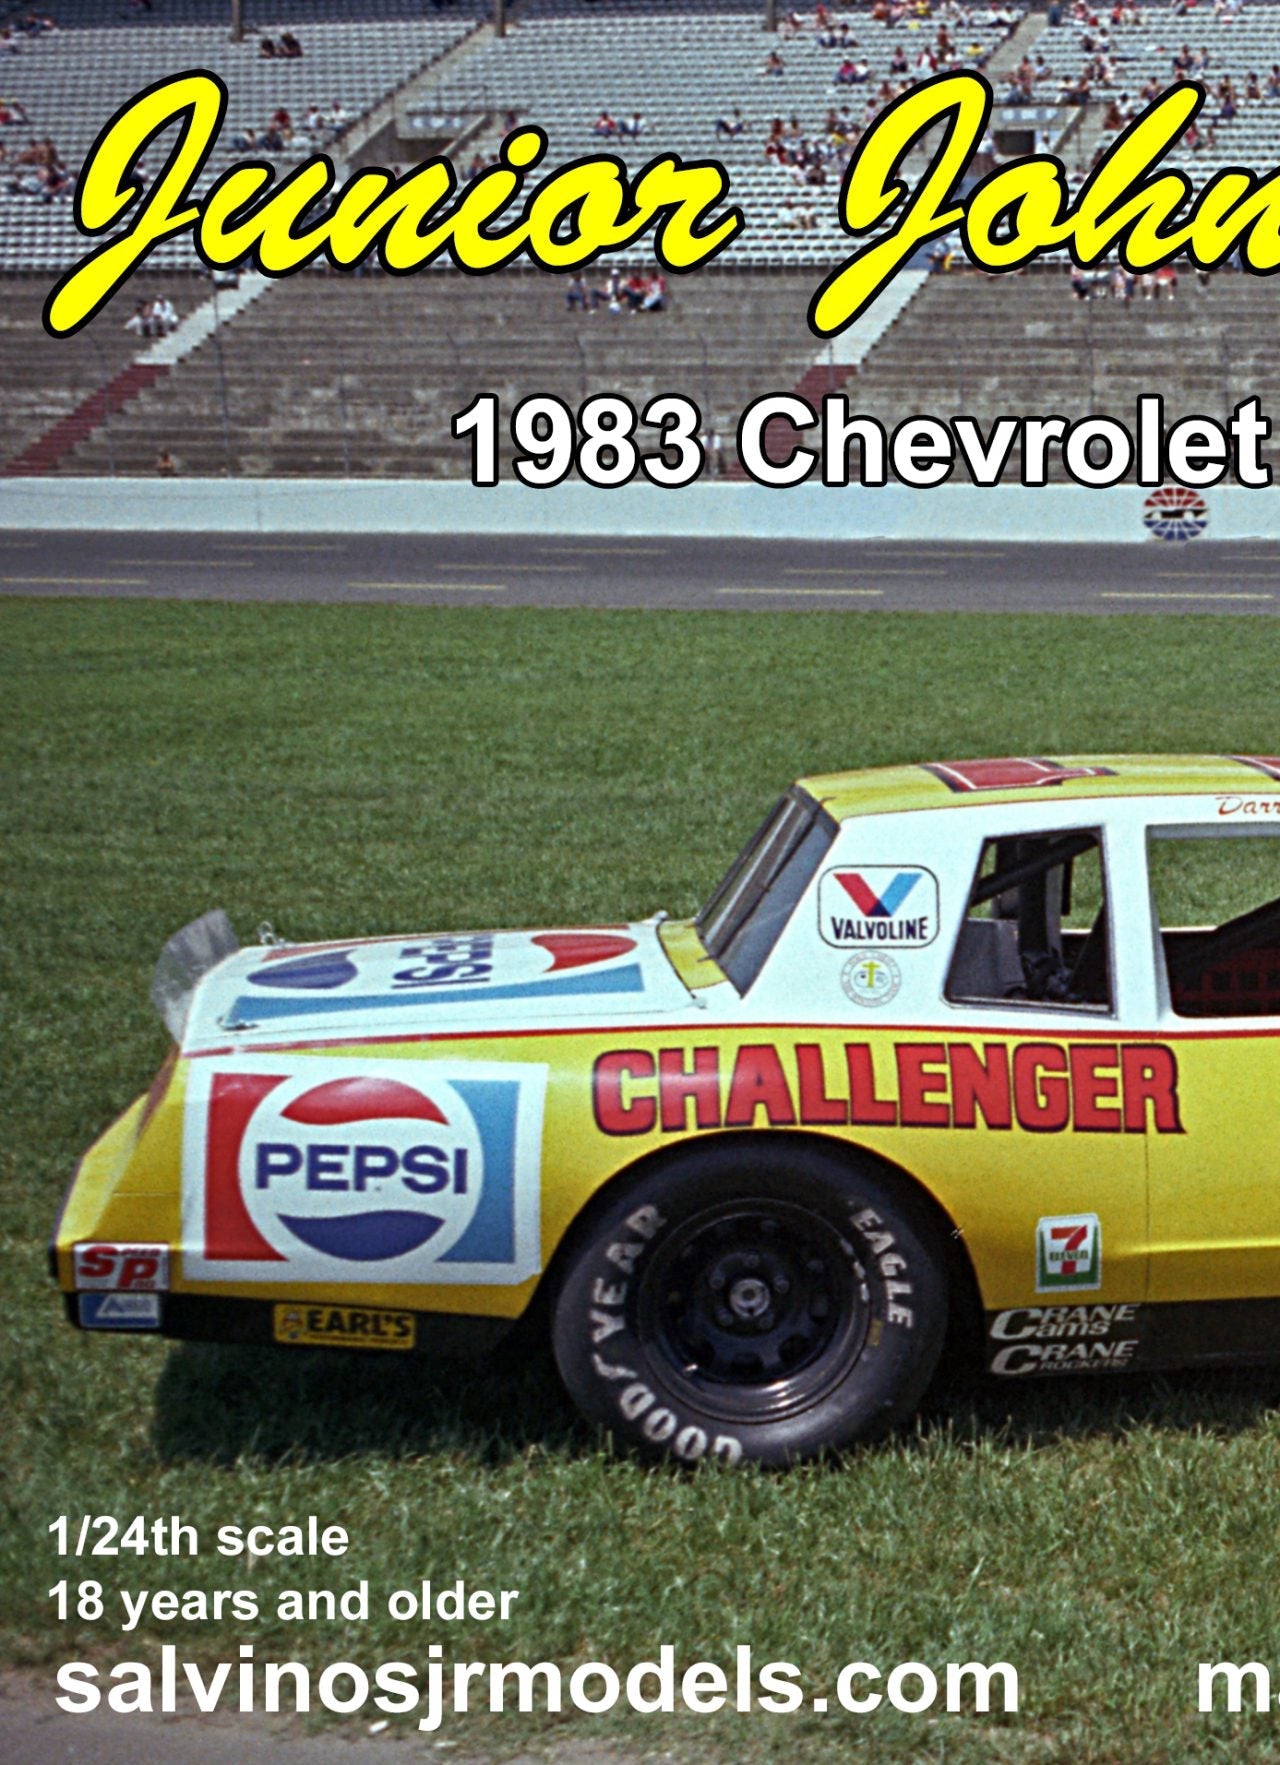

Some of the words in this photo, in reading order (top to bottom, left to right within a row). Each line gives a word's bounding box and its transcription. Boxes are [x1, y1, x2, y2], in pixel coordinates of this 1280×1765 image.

[831, 916, 928, 940] VALVOLINE
[593, 1042, 1186, 1137] CHALLENGER
[256, 1142, 468, 1195] PEPSI
[850, 1208, 913, 1329] EAGLE
[1050, 1225, 1088, 1276] 7
[307, 1309, 412, 1338] EARL'S
